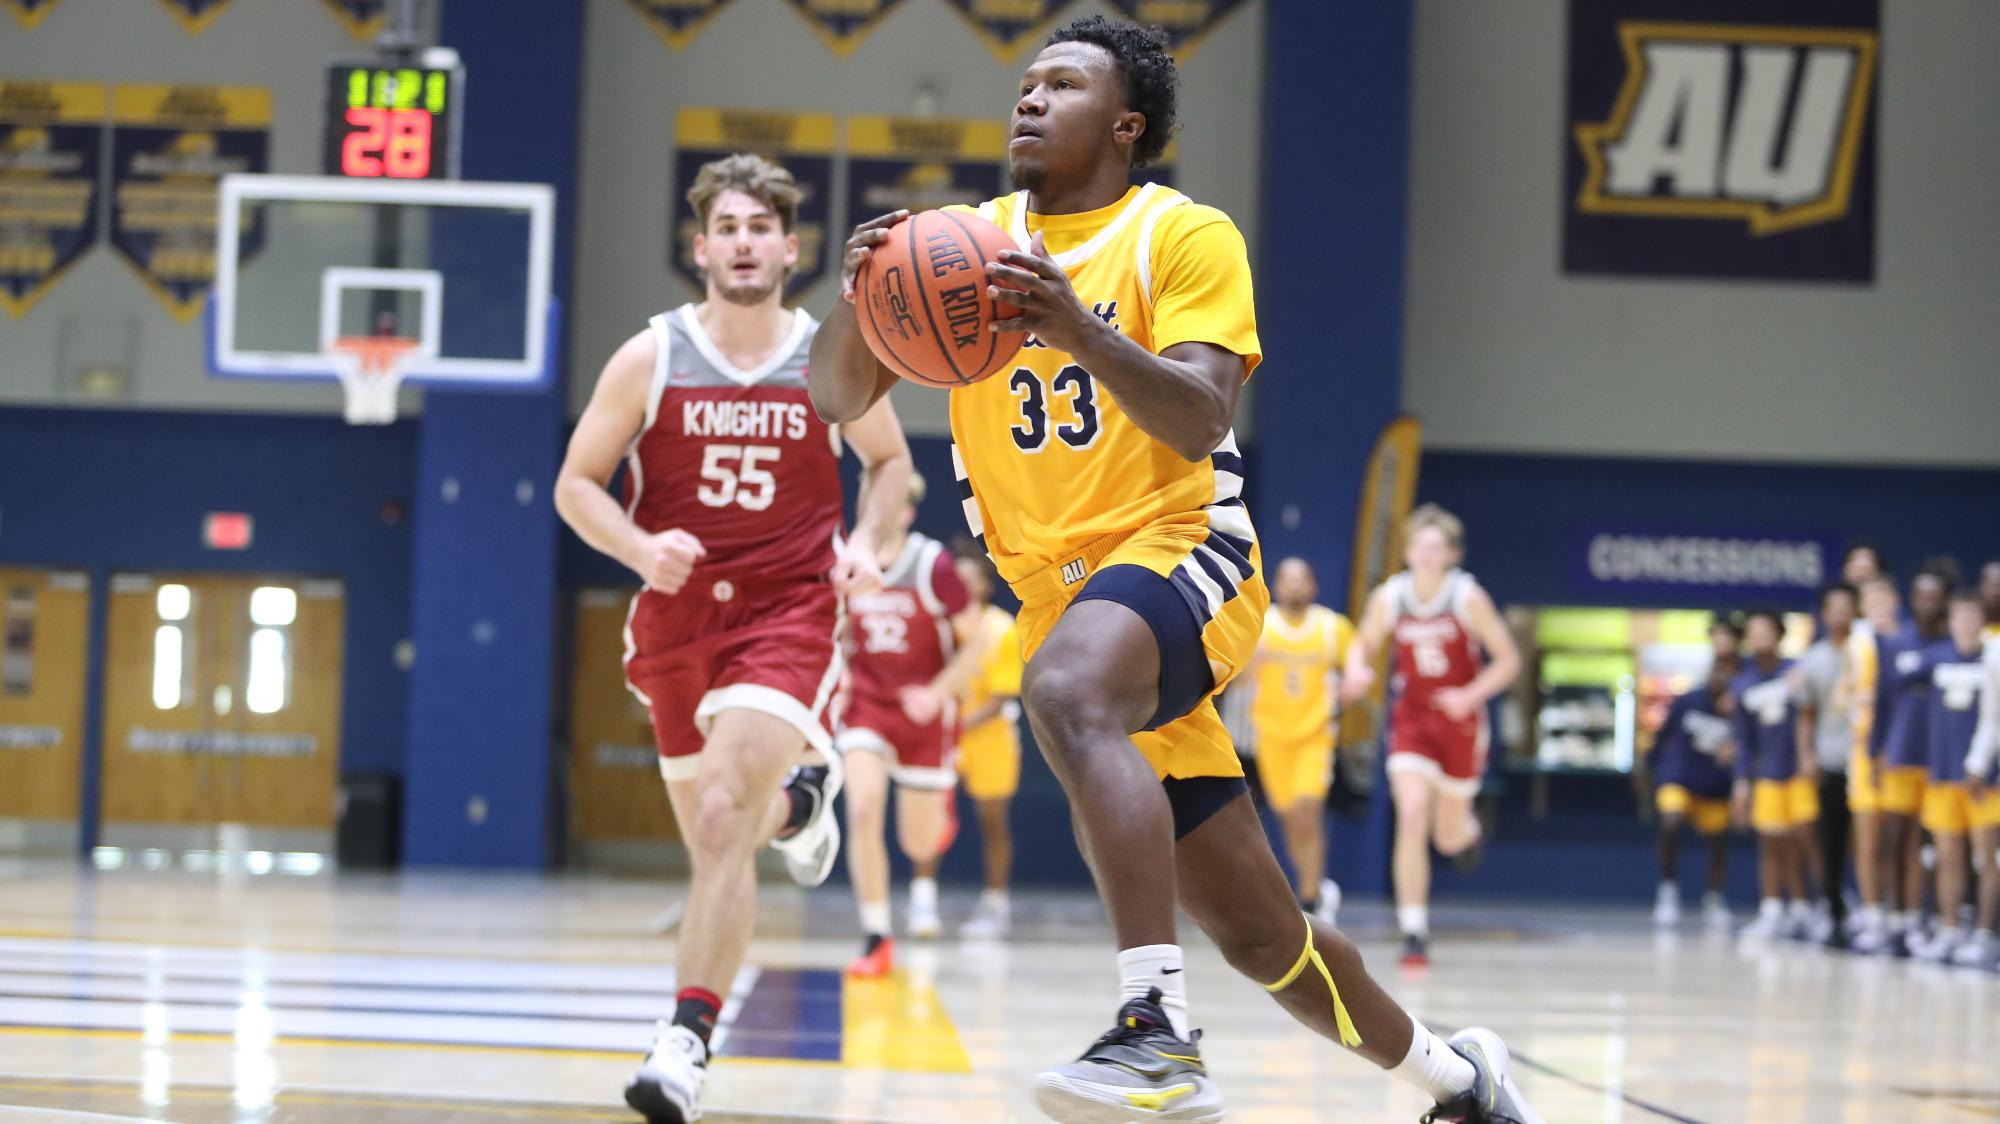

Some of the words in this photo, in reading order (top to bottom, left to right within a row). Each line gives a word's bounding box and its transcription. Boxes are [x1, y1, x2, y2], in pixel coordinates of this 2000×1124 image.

[341, 107, 432, 178] 28
[1604, 43, 1853, 205] AU
[926, 229, 971, 279] THE
[939, 282, 982, 351] ROCK
[682, 400, 808, 440] KNIGHTS
[1009, 363, 1104, 454] 33
[697, 443, 782, 511] 55
[1060, 557, 1087, 585] AU
[1589, 535, 1822, 587] CONCESSIONS
